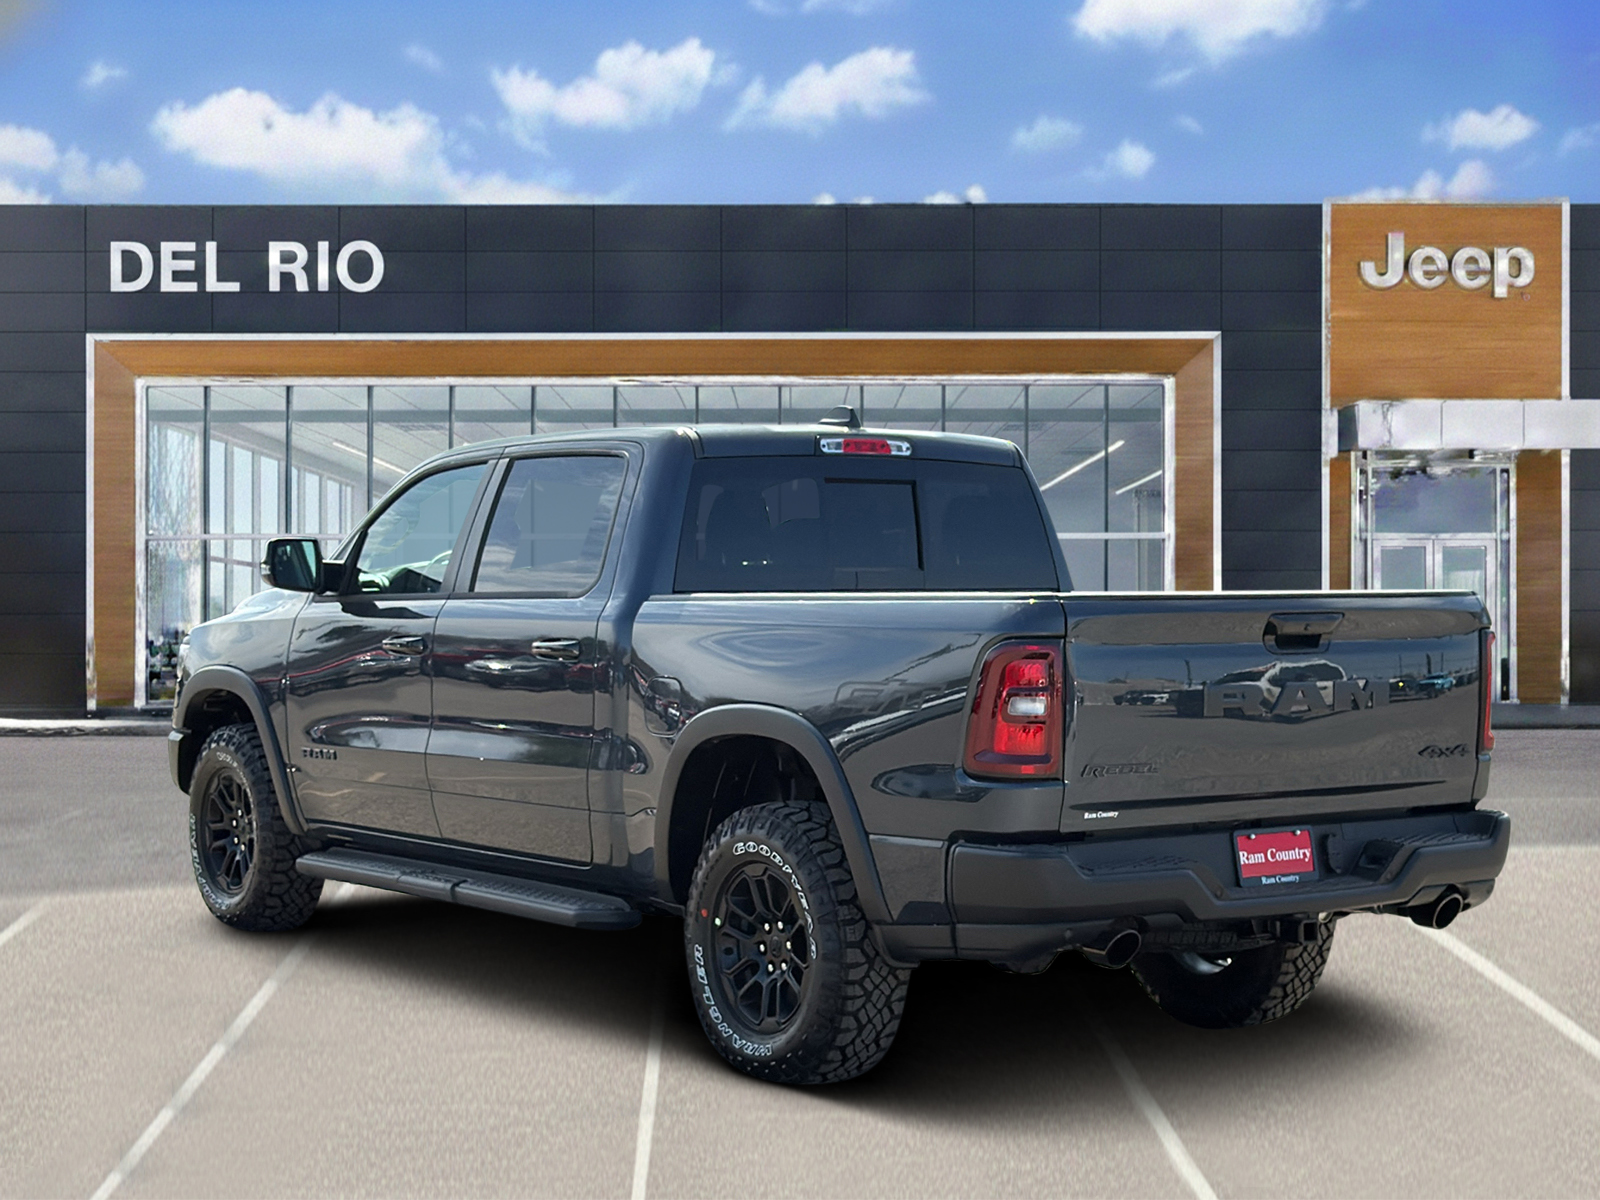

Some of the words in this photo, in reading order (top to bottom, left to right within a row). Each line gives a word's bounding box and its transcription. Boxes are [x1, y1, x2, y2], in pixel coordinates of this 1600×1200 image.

[110, 241, 240, 292] DEL
[268, 240, 384, 293] RIO
[1359, 231, 1535, 298] Jeep
[1204, 679, 1390, 717] RAM
[1081, 763, 1158, 778] REBEL
[1240, 850, 1265, 865] Ram
[1267, 847, 1311, 862] Country
[733, 841, 816, 959] GOODYEAR
[1261, 876, 1275, 885] Ram
[1276, 875, 1299, 883] Country
[694, 944, 773, 1056] WRANGLER
